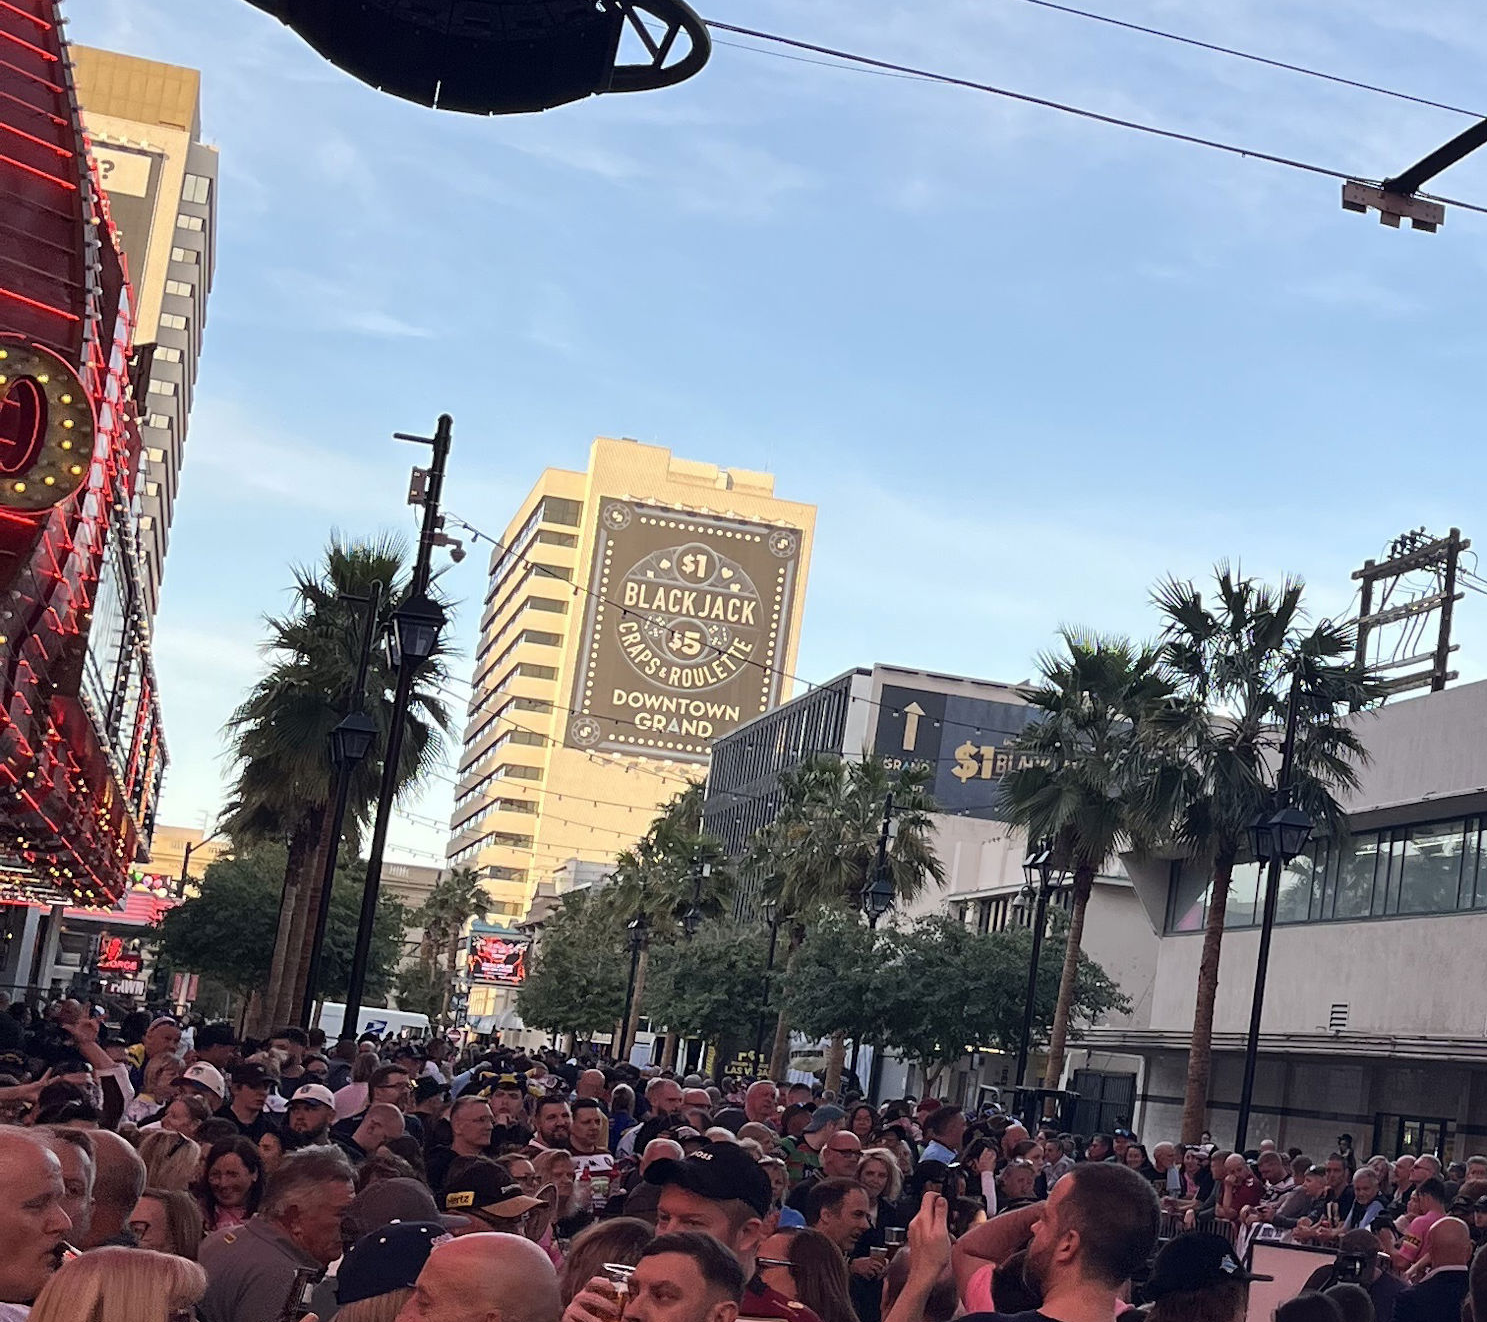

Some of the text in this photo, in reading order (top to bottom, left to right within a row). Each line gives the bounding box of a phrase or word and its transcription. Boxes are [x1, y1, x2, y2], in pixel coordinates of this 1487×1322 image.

[681, 554, 707, 578] $1
[619, 621, 661, 676] CRAPS
[668, 636, 753, 688] ROULETTE
[668, 631, 701, 655] $5
[612, 689, 741, 722] DOWNTOWN
[634, 712, 714, 738] GRAND
[951, 740, 995, 784] $1
